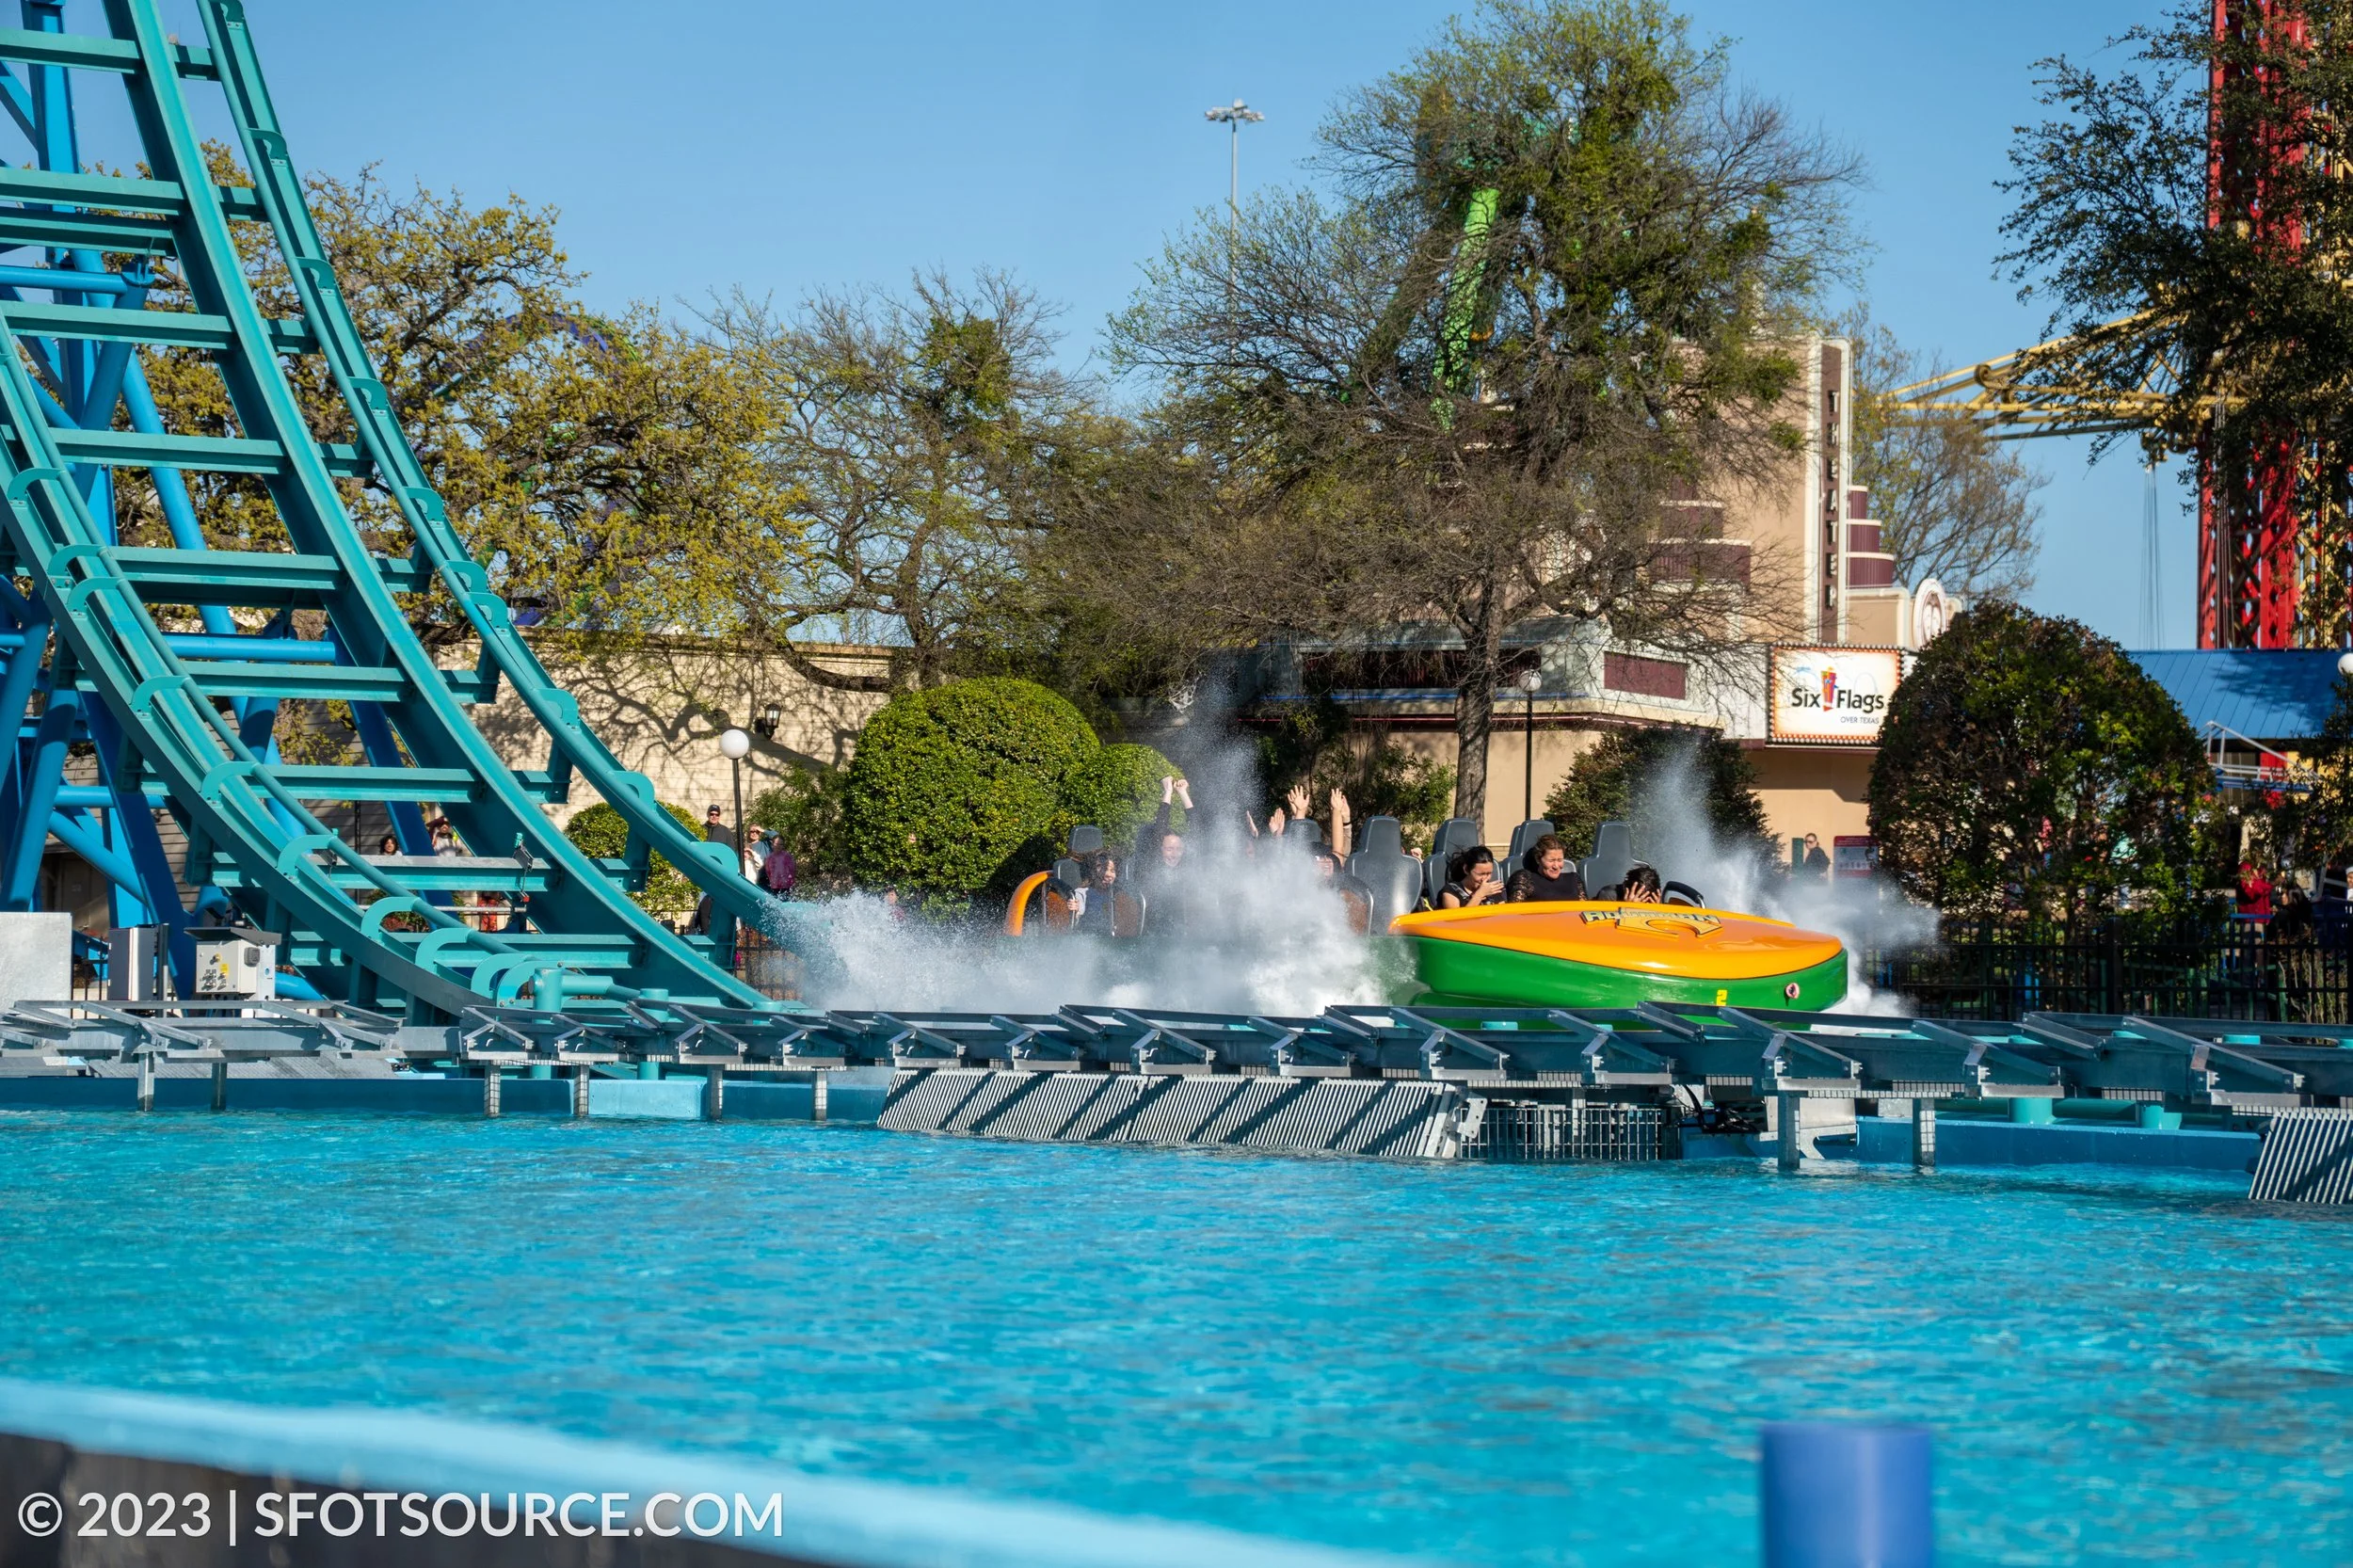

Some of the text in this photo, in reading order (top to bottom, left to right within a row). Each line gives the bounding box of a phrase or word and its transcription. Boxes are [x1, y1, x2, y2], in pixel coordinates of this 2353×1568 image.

[1826, 390, 1840, 608] THEATER
[1791, 688, 1884, 713] Six Flags
[1860, 716, 1880, 725] TEXAS
[1716, 989, 1728, 1006] 2
